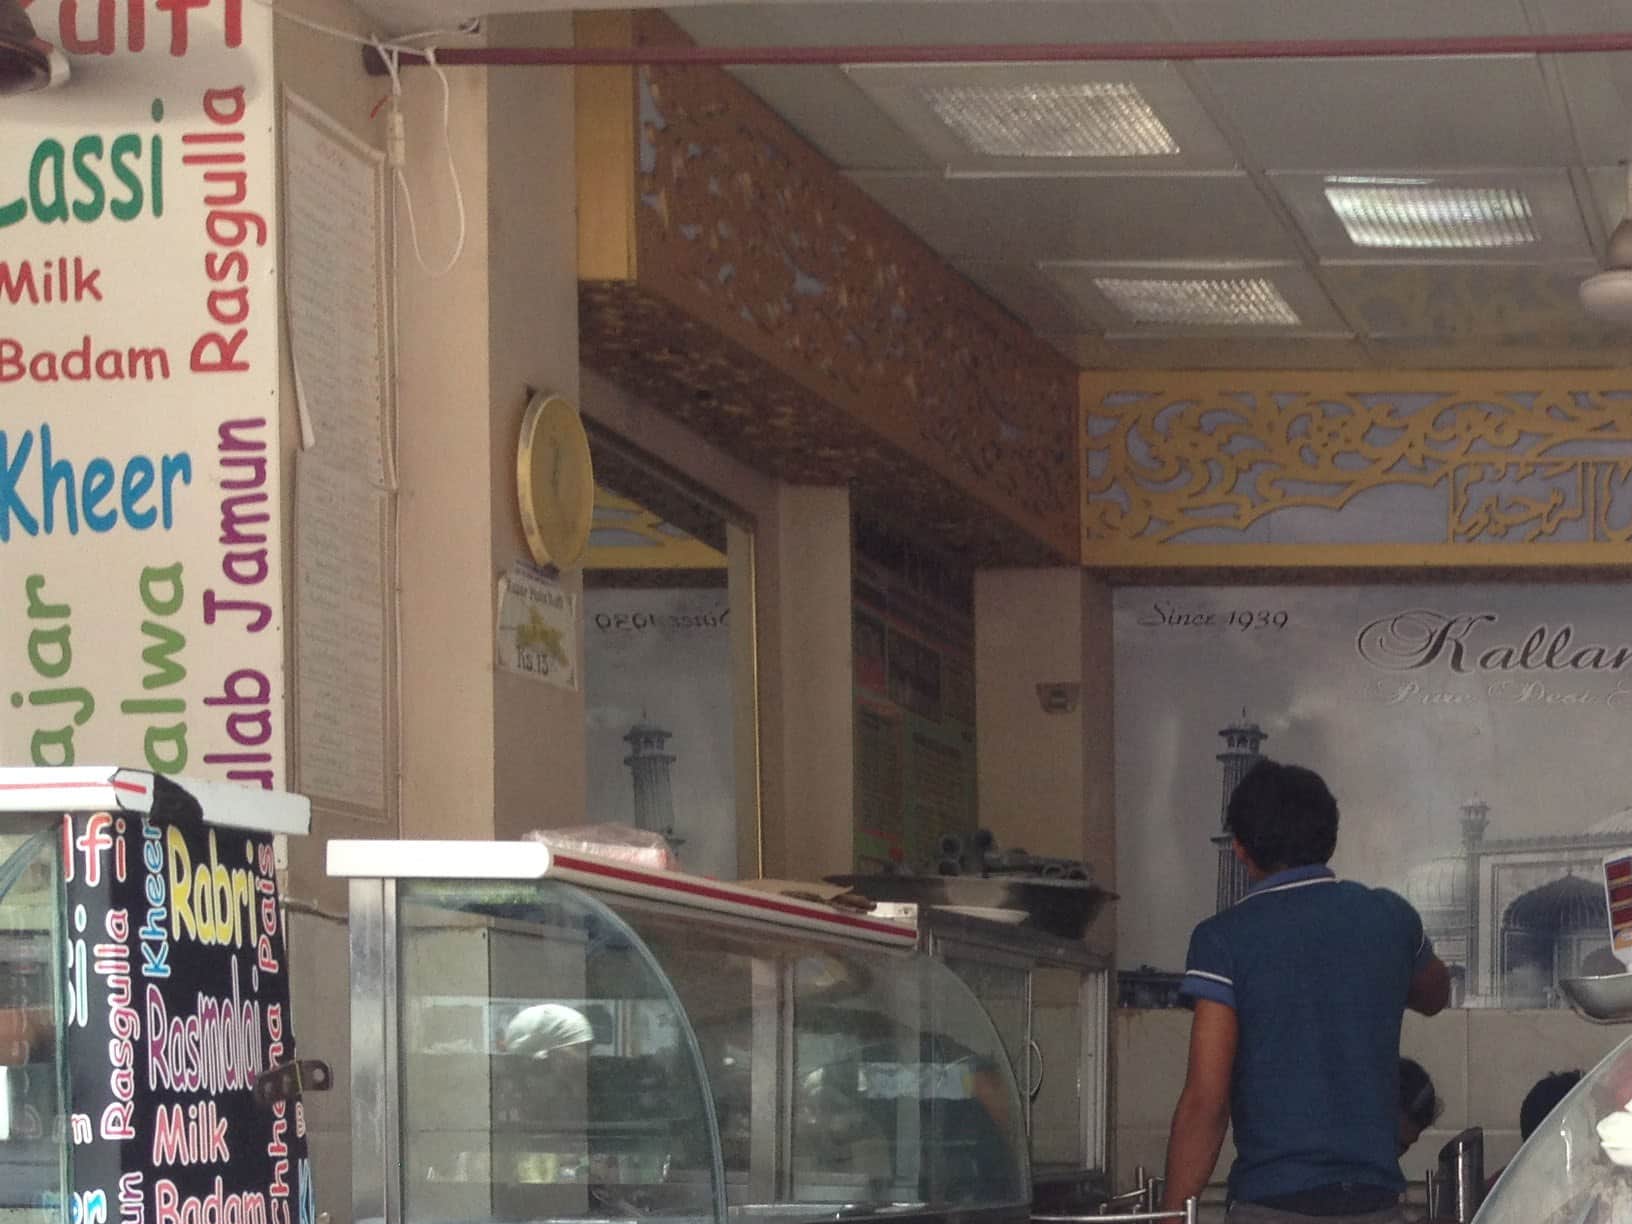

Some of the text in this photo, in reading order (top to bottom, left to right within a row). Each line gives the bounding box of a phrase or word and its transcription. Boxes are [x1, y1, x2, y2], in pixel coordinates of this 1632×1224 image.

[0, 98, 164, 228] assi
[190, 85, 267, 373] Rasgulla
[0, 338, 170, 382] Badam
[0, 423, 191, 542] Kheer
[202, 417, 270, 632] Jamun
[1138, 600, 1290, 632] Since 1939
[167, 825, 258, 948] Rabri
[257, 842, 279, 974] Pais
[93, 907, 141, 1140] Rasgulla
[146, 955, 264, 1093] Rasmalai
[152, 1101, 230, 1167] Milk
